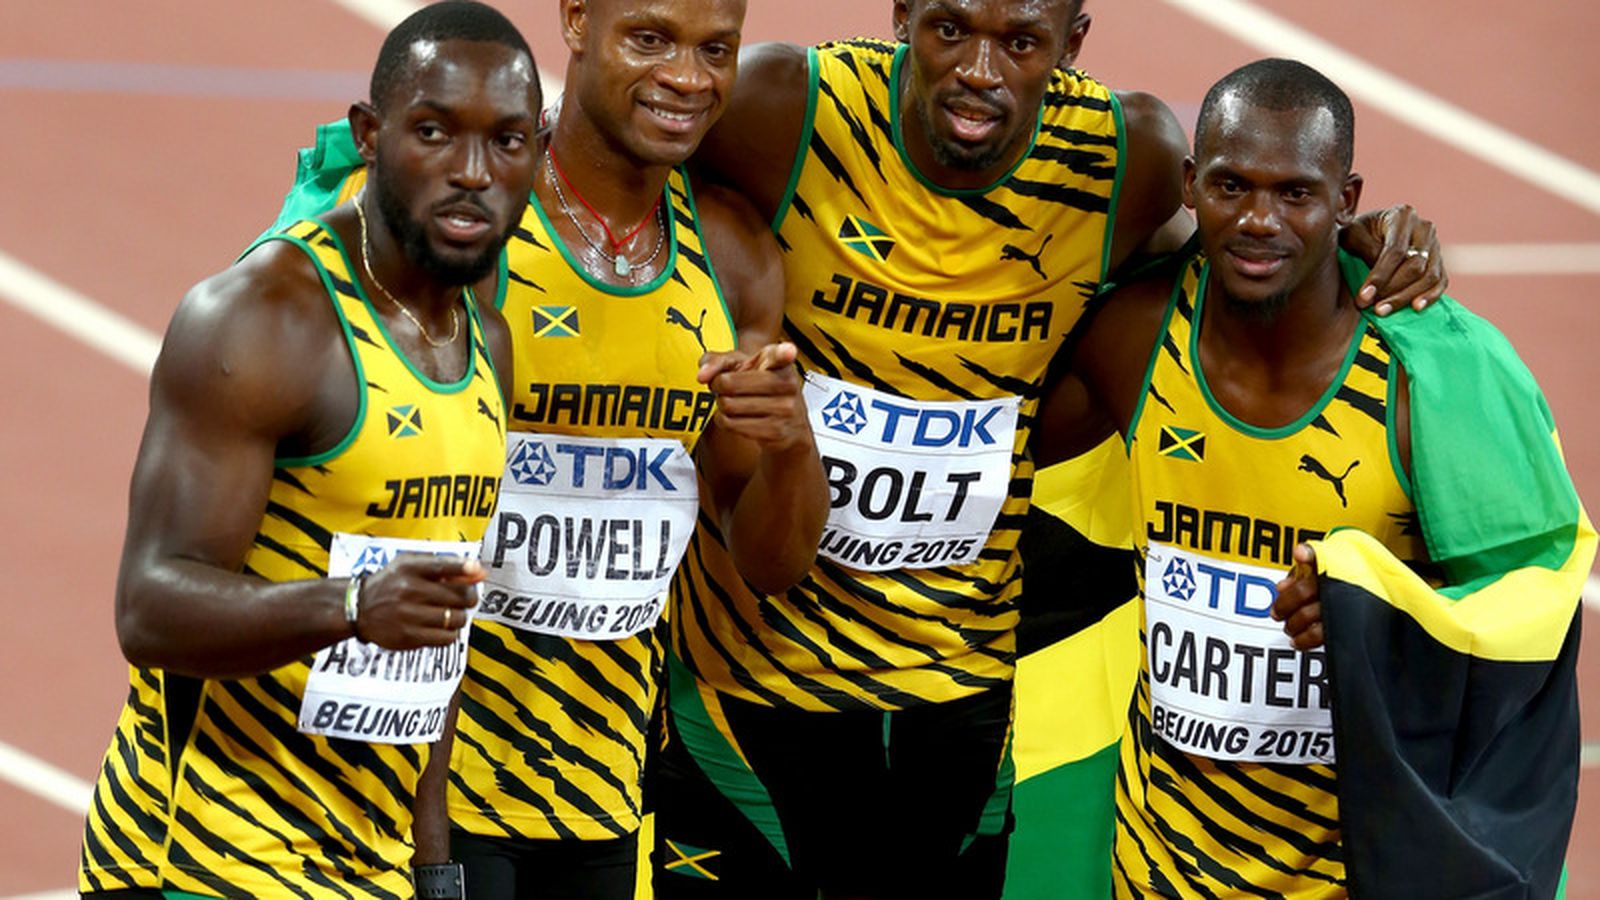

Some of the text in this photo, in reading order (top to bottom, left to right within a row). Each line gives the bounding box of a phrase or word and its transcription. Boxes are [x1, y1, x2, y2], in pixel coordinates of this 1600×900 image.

[812, 273, 1053, 342] JAMAICA
[513, 383, 716, 432] JAMAICA
[872, 399, 1003, 447] TDK
[556, 443, 677, 491] TDK
[821, 456, 982, 523] BOLT
[492, 511, 671, 581] POWELL
[902, 539, 977, 564] 2015
[478, 589, 608, 633] BEIJING
[1151, 621, 1328, 709] CARTER
[312, 700, 421, 738] BEIJING
[1152, 705, 1333, 757] BEIJING 2015
